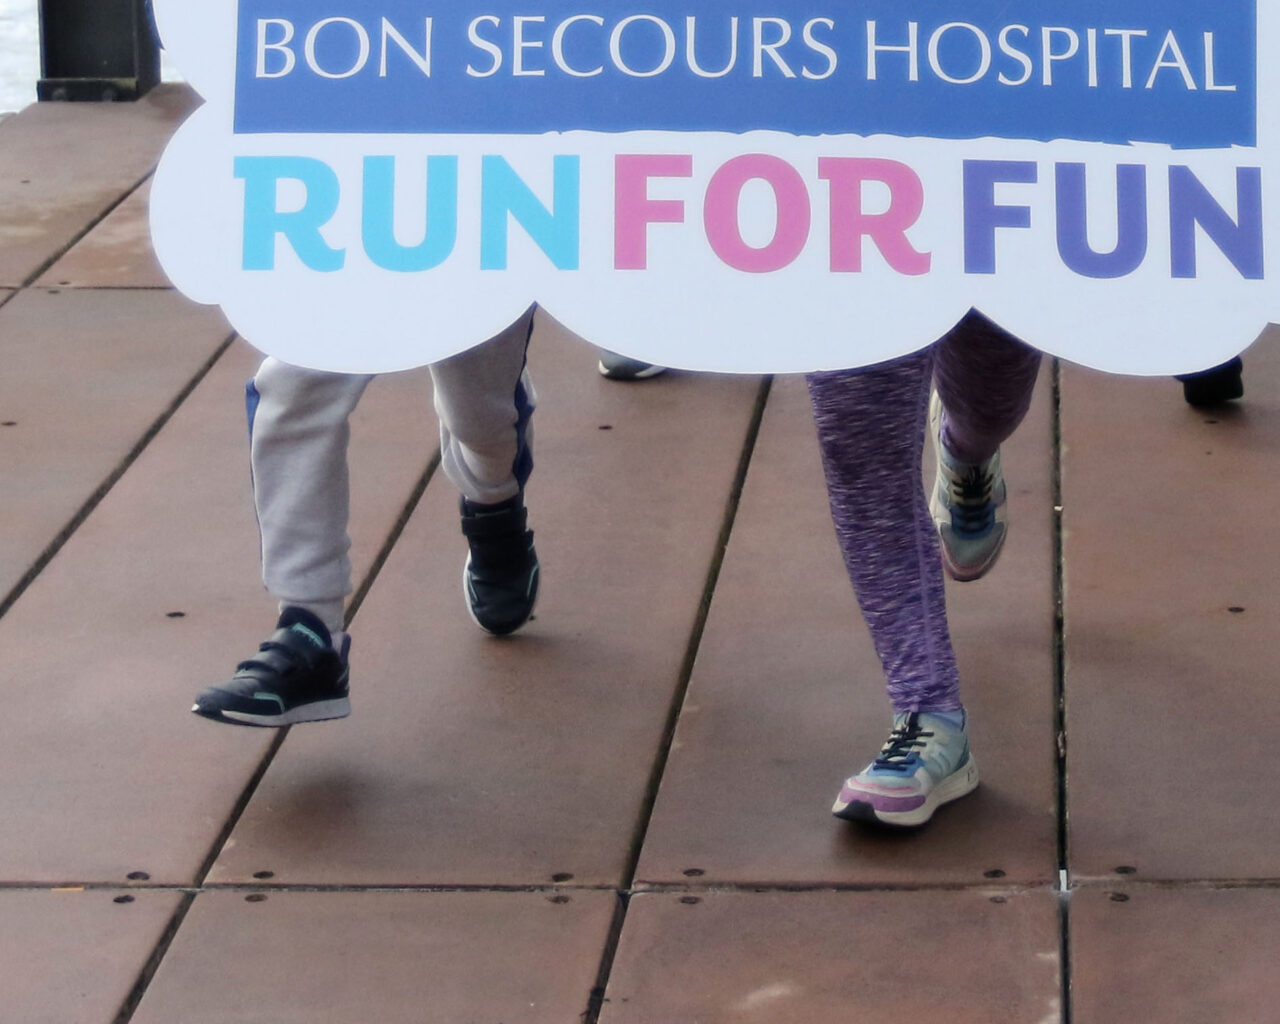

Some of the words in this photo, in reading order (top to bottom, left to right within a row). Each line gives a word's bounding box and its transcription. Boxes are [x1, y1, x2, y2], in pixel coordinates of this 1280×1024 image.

[255, 16, 433, 79] BON
[465, 14, 838, 80] SECOURS
[866, 20, 1237, 91] HOSPITAL
[963, 158, 1265, 280] FUN
